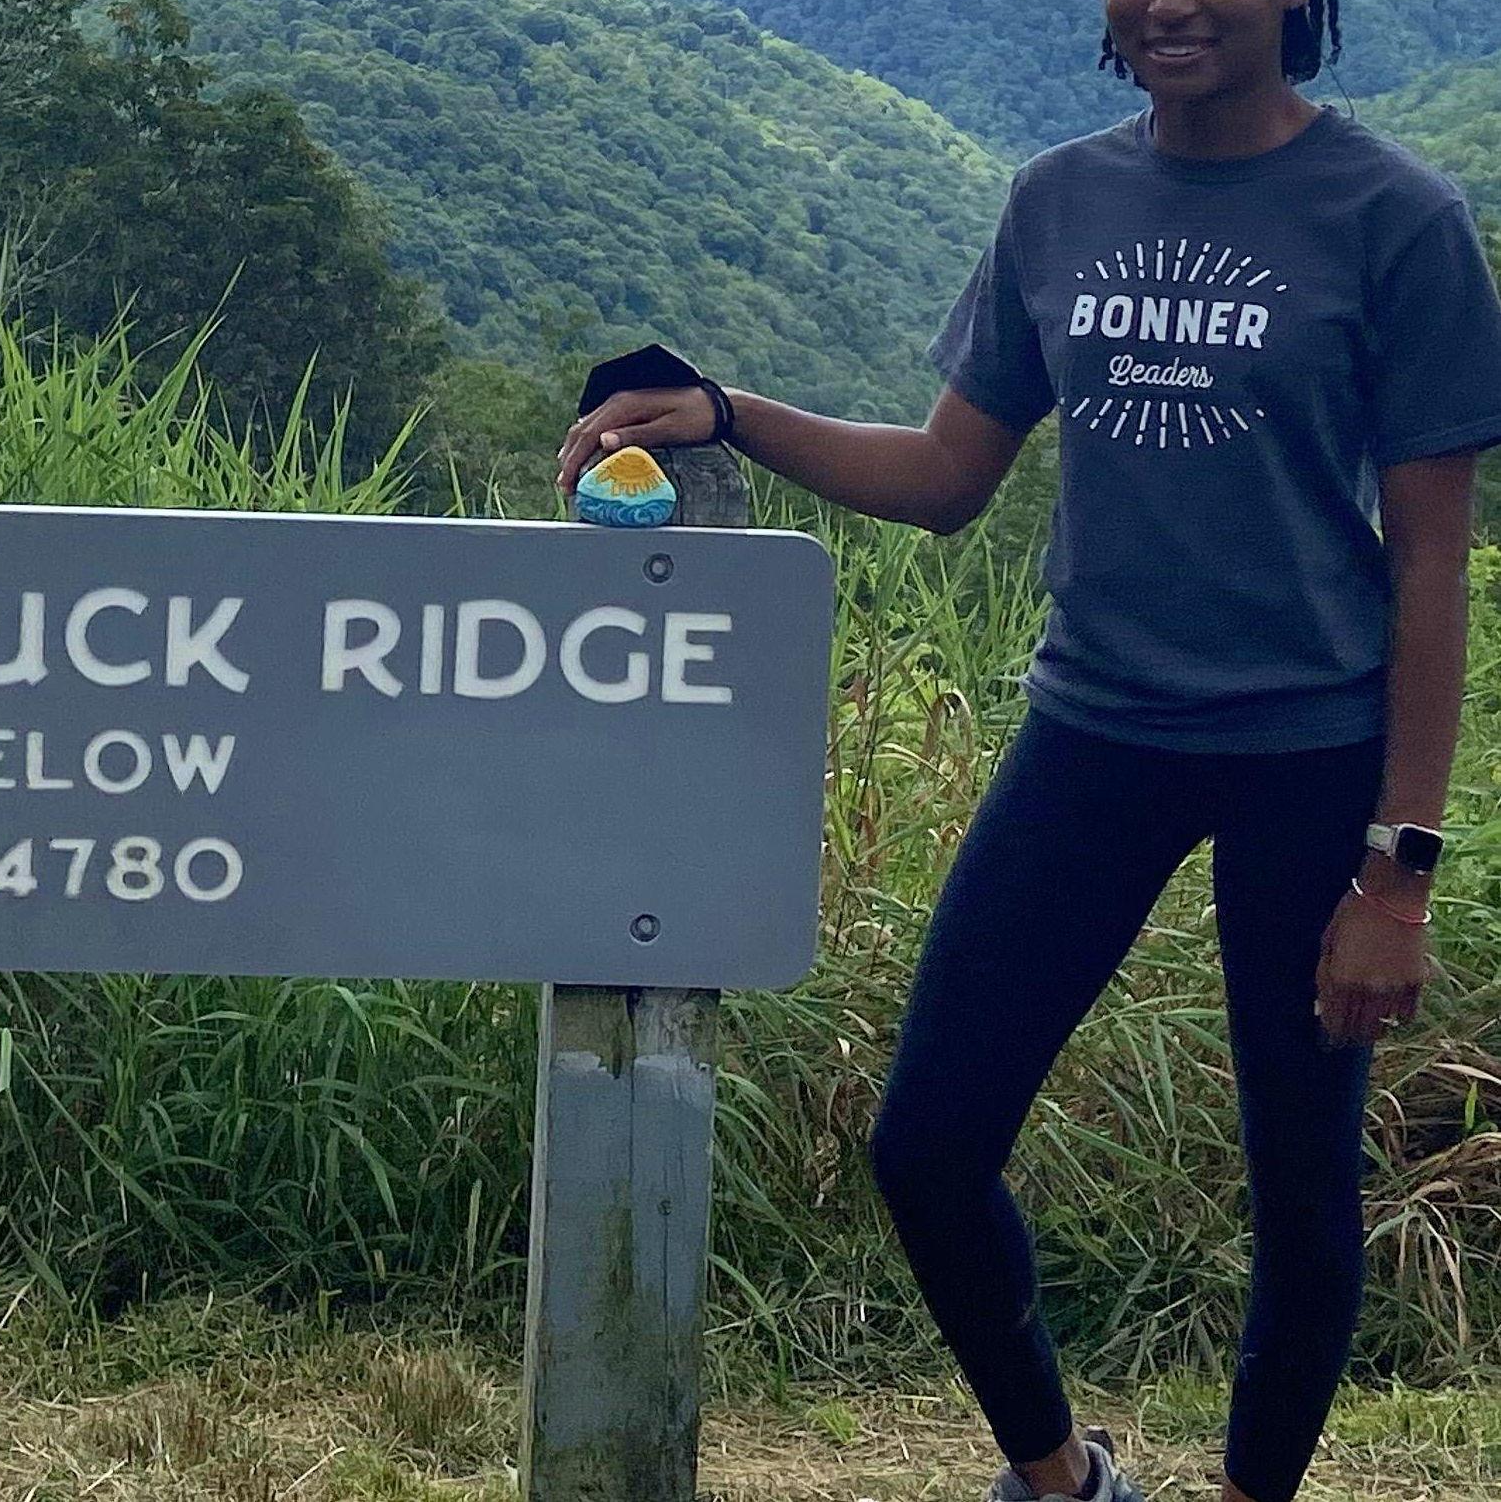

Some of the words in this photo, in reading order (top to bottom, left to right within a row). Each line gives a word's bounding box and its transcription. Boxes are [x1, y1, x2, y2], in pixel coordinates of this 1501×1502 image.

[1068, 294, 1269, 349] BONNER
[1108, 354, 1214, 388] Leaders
[322, 599, 733, 704] RIDGE
